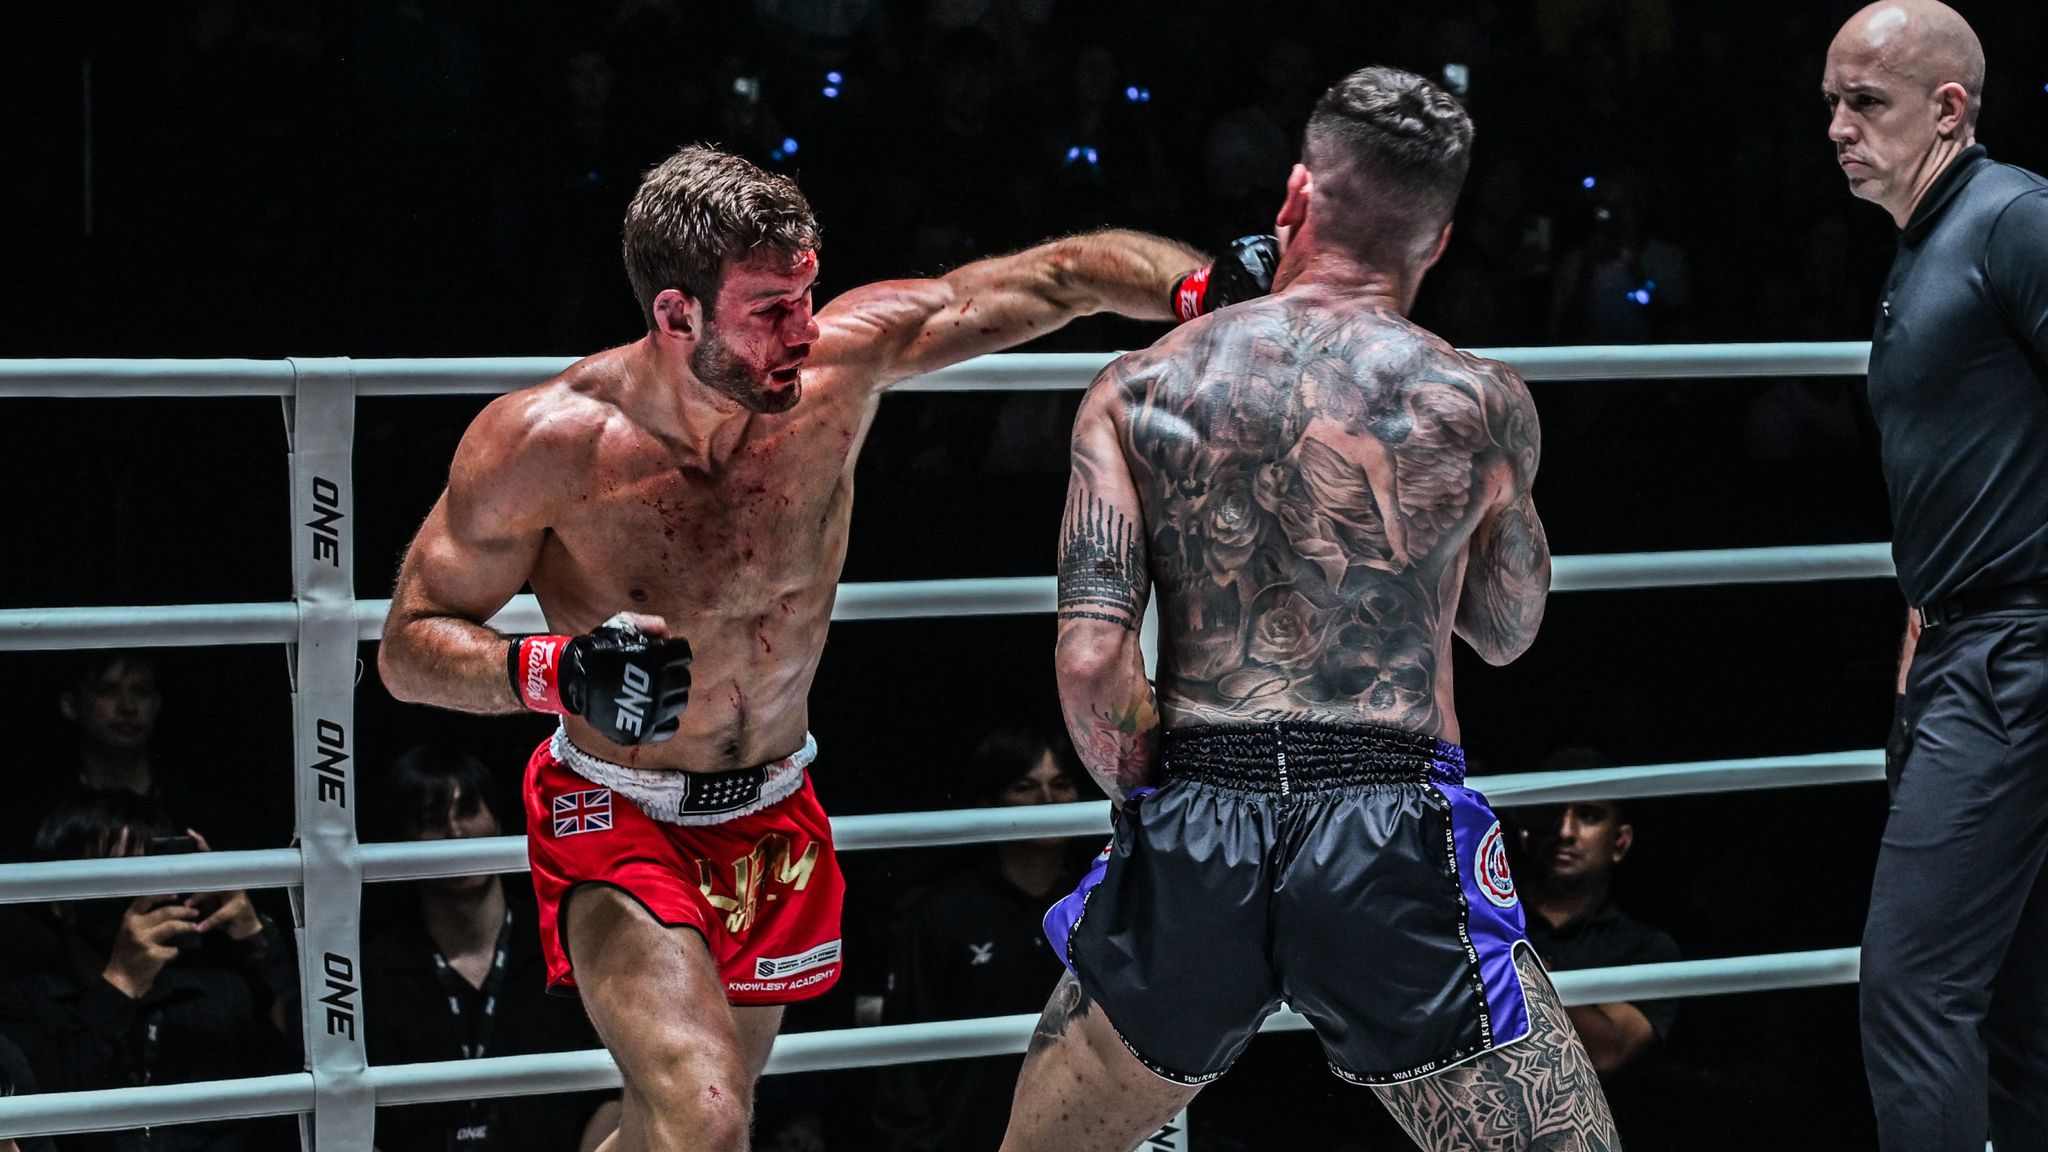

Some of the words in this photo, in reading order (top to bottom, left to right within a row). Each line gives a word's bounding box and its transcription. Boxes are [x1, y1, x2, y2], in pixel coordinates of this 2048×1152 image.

[305, 476, 345, 567] ONE
[526, 640, 557, 702] Fairtex
[614, 662, 653, 738] ONE
[309, 718, 350, 809] ONE
[1277, 752, 1288, 776] KRU
[1279, 777, 1290, 797] WAI
[1446, 829, 1454, 851] KRU
[1458, 922, 1469, 943] KRU
[1465, 945, 1477, 964] WAI
[728, 982, 788, 991] KNOWLESY
[788, 969, 836, 990] ACADEMY
[318, 952, 359, 1042] ONE
[1480, 1014, 1490, 1037] KRU
[1482, 1038, 1491, 1050] AI
[1392, 1070, 1412, 1080] WAI
[1414, 1061, 1435, 1076] KRU
[456, 1125, 488, 1140] ONE
